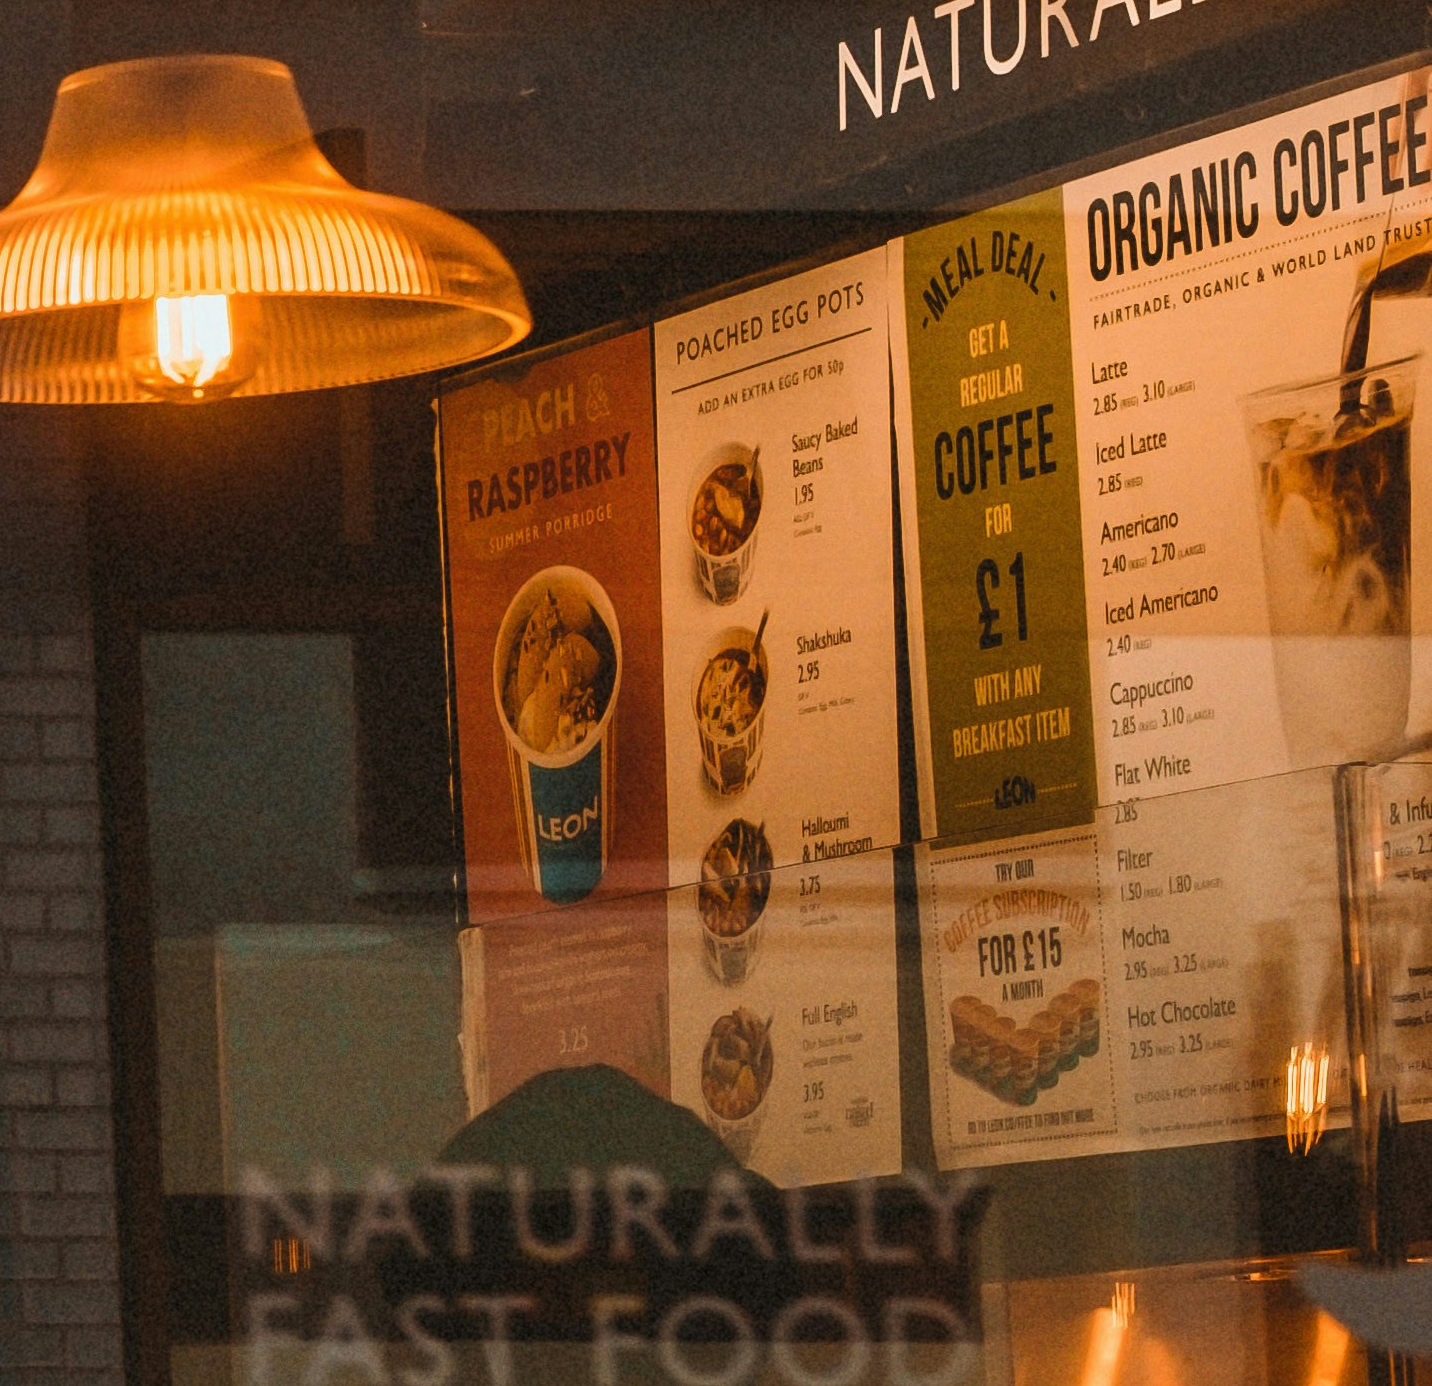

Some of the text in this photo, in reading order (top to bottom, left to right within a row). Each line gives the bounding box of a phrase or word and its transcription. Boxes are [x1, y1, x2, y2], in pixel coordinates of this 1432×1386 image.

[1086, 94, 1432, 282] ORGANIC COFFEE
[922, 230, 1046, 323] MEAL DEAL
[1093, 216, 1432, 330] FAIRTRADE, ORGANIC & WORLD LAND TRUST
[676, 281, 864, 365] POACHED EGG POTS
[969, 319, 1010, 358] GET A
[698, 397, 720, 416] ADD
[723, 391, 738, 407] AN
[741, 379, 775, 404] EXTRA
[778, 371, 799, 392] EGG
[803, 363, 823, 384] FOR
[960, 363, 1024, 408] REGULAR
[1092, 358, 1129, 385] Latte
[1093, 379, 1165, 416] 2.85 3.10
[483, 381, 576, 453] PEACH
[792, 415, 858, 454] Saucy Baked
[934, 403, 1057, 500] COFFEE
[1096, 429, 1167, 466] Iced Latte
[466, 431, 631, 522] RASPBERRY
[792, 457, 824, 478] Beans
[1097, 472, 1122, 496] 2.85
[794, 482, 814, 506] 1.95
[488, 502, 614, 556] SUMMER PORRIDGE
[985, 502, 1013, 538] FOR
[1100, 511, 1179, 546] Americano
[1102, 541, 1176, 577] 2.40 2.70
[975, 551, 1028, 651] £1
[1105, 583, 1219, 626] Iced Americano
[797, 626, 852, 655] Shakshuka
[1106, 633, 1131, 657] 2.40
[797, 660, 819, 684] 2.95
[973, 663, 1042, 707] WITH ANY
[1109, 671, 1194, 709] Cappuccino
[953, 706, 1071, 758] BREAKFAST ITEM
[1112, 706, 1185, 738] 2.85 3.10
[1115, 754, 1192, 787] Flat White
[994, 774, 1037, 811] LEON
[538, 794, 599, 842] LEON
[802, 811, 850, 839] Halloumi
[1015, 858, 1034, 879] OUR
[1116, 848, 1154, 873] Filter
[1120, 881, 1142, 903] 1.50
[992, 887, 1090, 935] SUBSCRIPTION
[977, 925, 1063, 978] FOR £15
[1121, 923, 1170, 950] Mocha
[1124, 953, 1197, 981] 2.95 3.25
[1002, 978, 1044, 1004] A MONTH
[802, 1005, 821, 1027] Full
[1127, 996, 1236, 1029] Hot Chocolate
[1130, 1038, 1154, 1060] 2.95
[237, 1162, 988, 1264] NATURALLY
